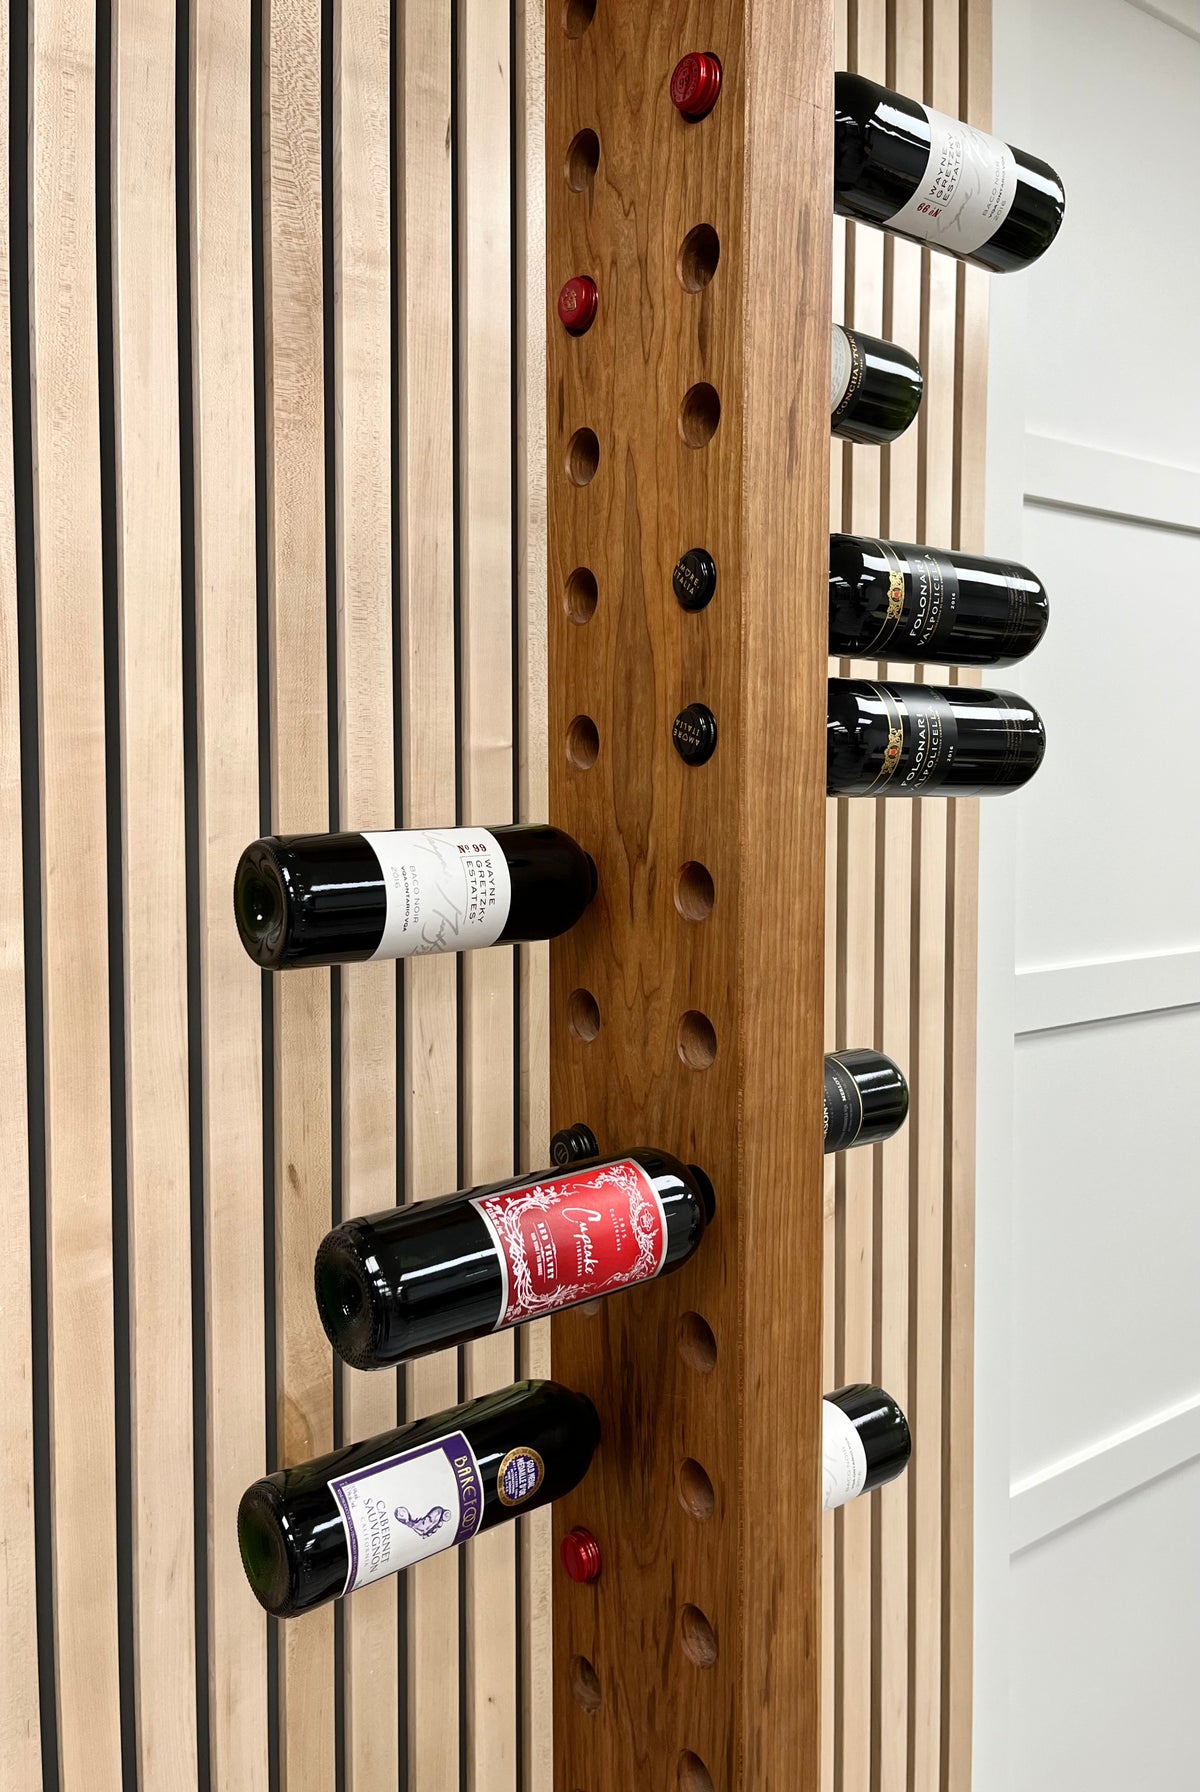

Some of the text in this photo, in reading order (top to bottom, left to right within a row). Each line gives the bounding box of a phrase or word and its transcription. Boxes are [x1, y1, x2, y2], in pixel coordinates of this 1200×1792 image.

[929, 147, 949, 197] WAYNE
[936, 133, 957, 199] GRETZKY
[944, 140, 962, 202] ESTATES
[916, 202, 929, 214] 99
[982, 187, 998, 216] BACO
[836, 368, 859, 415] CONCHA
[673, 570, 695, 596] ITALIA
[909, 559, 928, 636] FOLONARI
[916, 554, 940, 646] VALPOLICELLA
[675, 718, 700, 737] ITALIA
[900, 713, 926, 786] FOLONARI
[906, 704, 939, 792] VALPOLICELLA
[472, 844, 487, 852] 99
[390, 866, 400, 888] 2016
[404, 883, 412, 919] ONTARIO
[409, 865, 422, 924] BACO NOIR
[466, 860, 478, 925] ESTATES
[475, 860, 487, 924] GRETZKY
[484, 858, 496, 906] WAYNE
[402, 918, 410, 932] VQA
[832, 1076, 846, 1102] MERLOT
[537, 1222, 554, 1280] RED VELVET
[562, 1207, 602, 1275] Cupcake
[575, 1238, 583, 1278] VINEYARDS
[454, 1455, 478, 1534] BAREFOOT
[516, 1456, 527, 1497] MÉDAILLE D'OR
[526, 1459, 536, 1489] GOLD MEDAL
[361, 1516, 369, 1568] CALIFORNIA
[364, 1498, 379, 1574] SAUVIGNON
[376, 1500, 392, 1564] CABERNET
